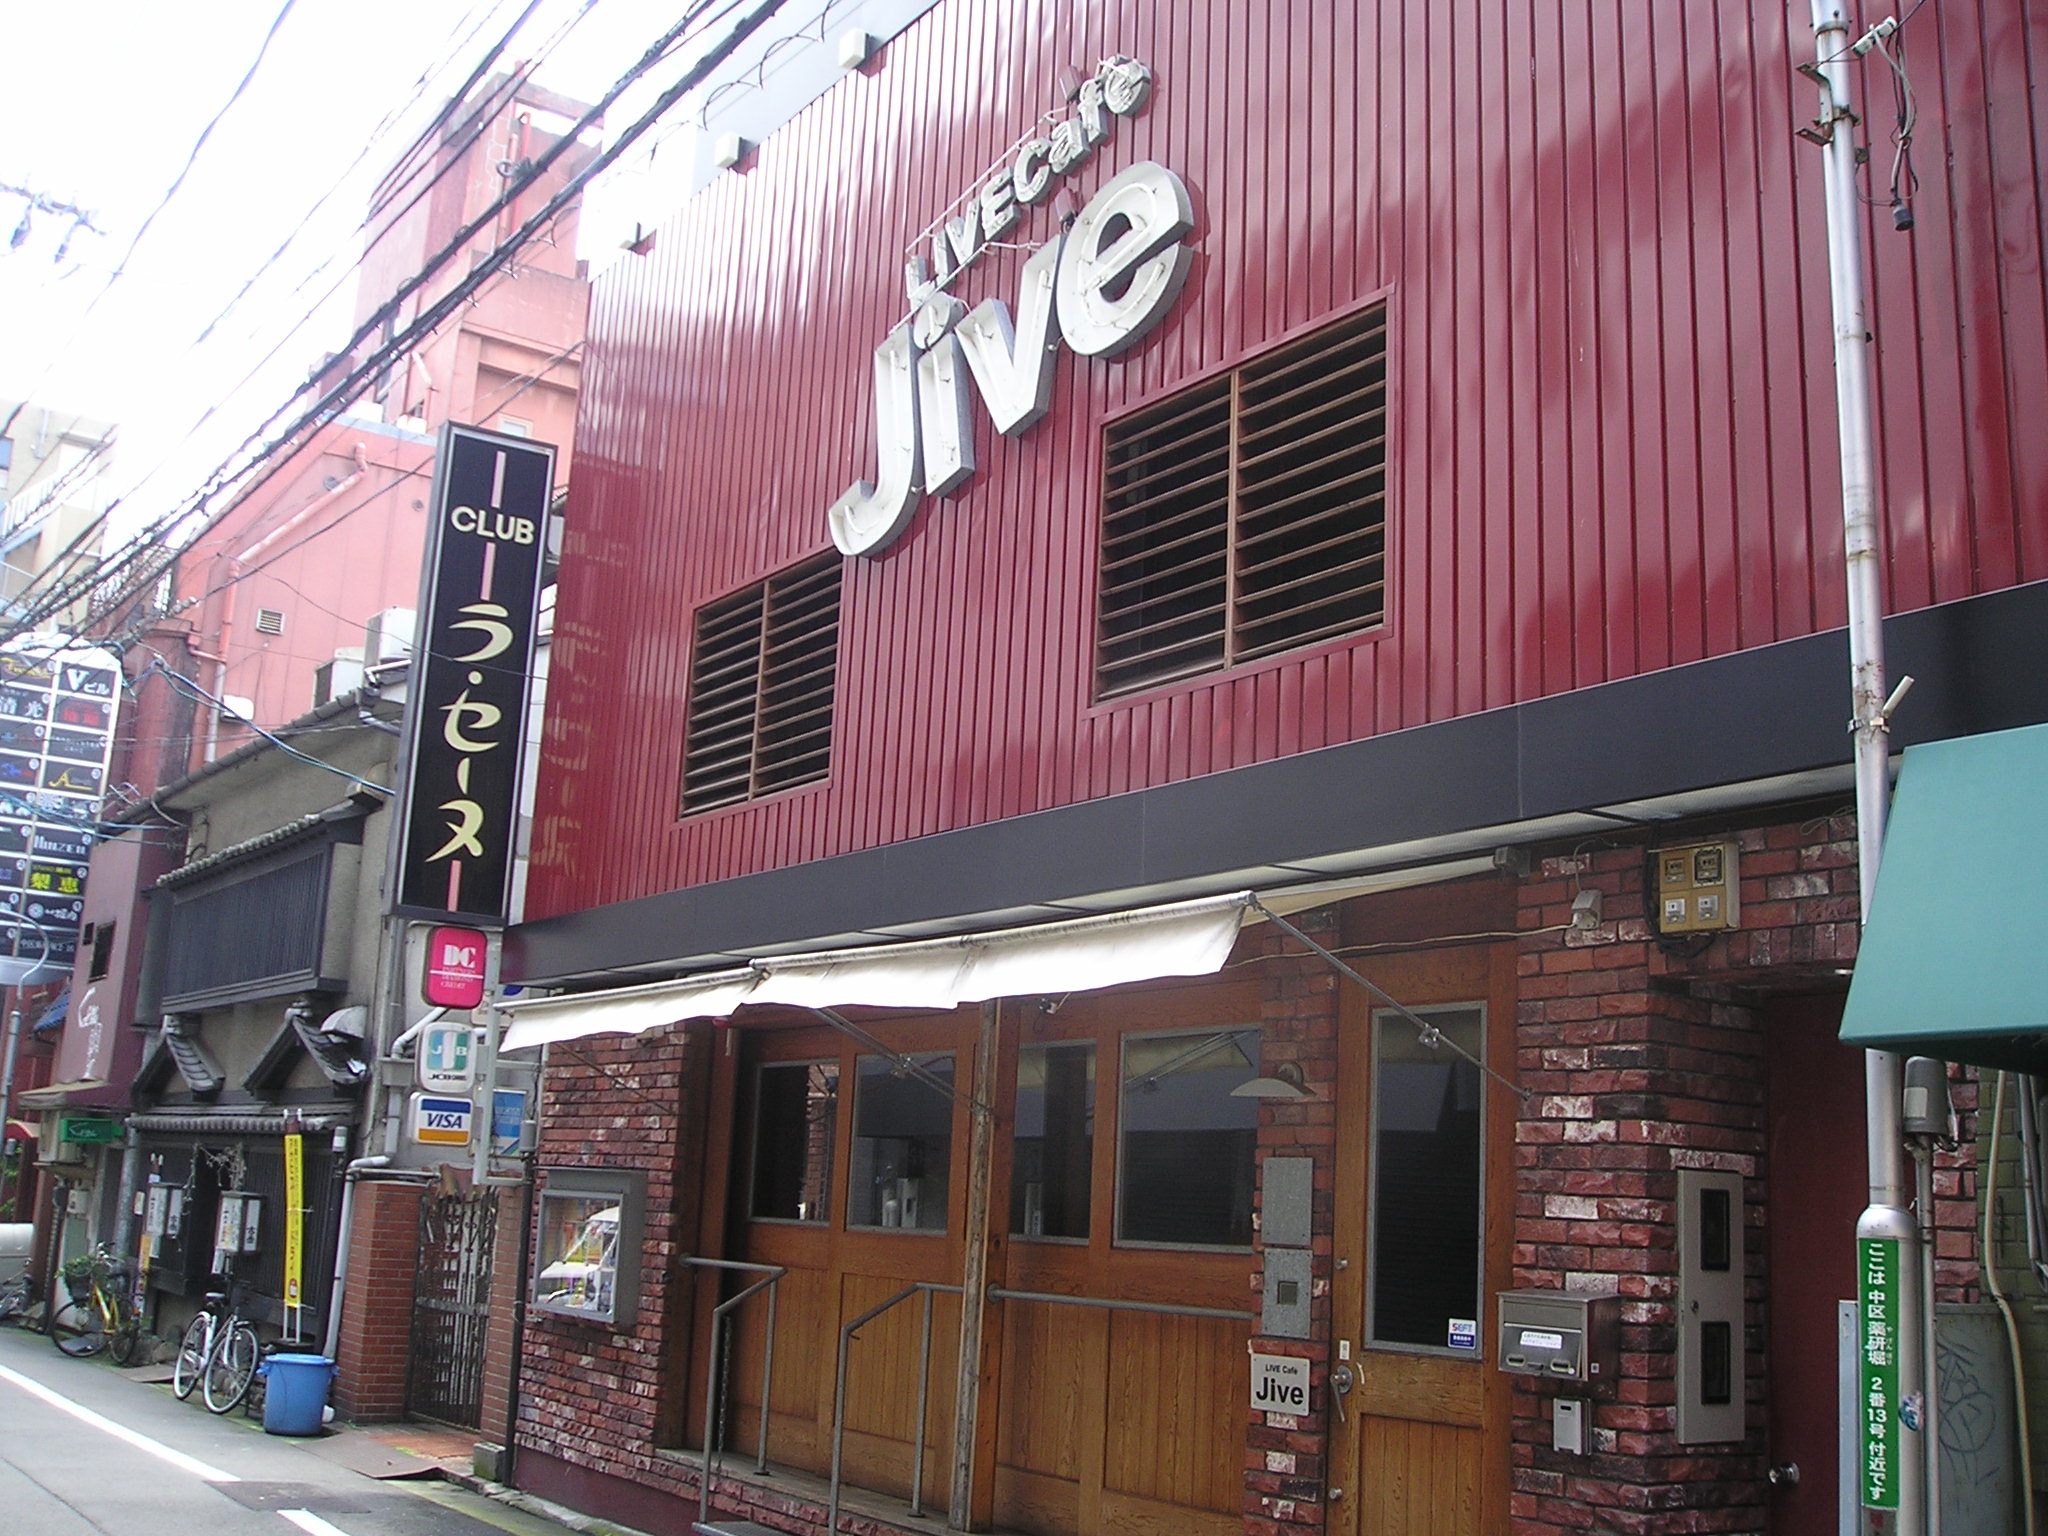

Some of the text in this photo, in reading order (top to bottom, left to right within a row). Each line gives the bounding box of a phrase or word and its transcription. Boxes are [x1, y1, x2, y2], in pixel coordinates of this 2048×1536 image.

[451, 505, 536, 546] CLUB
[425, 602, 515, 863] ラ・セーヌ
[443, 944, 476, 968] DC
[427, 1112, 462, 1129] VISA
[1265, 1364, 1281, 1373] LIVE
[1256, 1376, 1304, 1406] Jive
